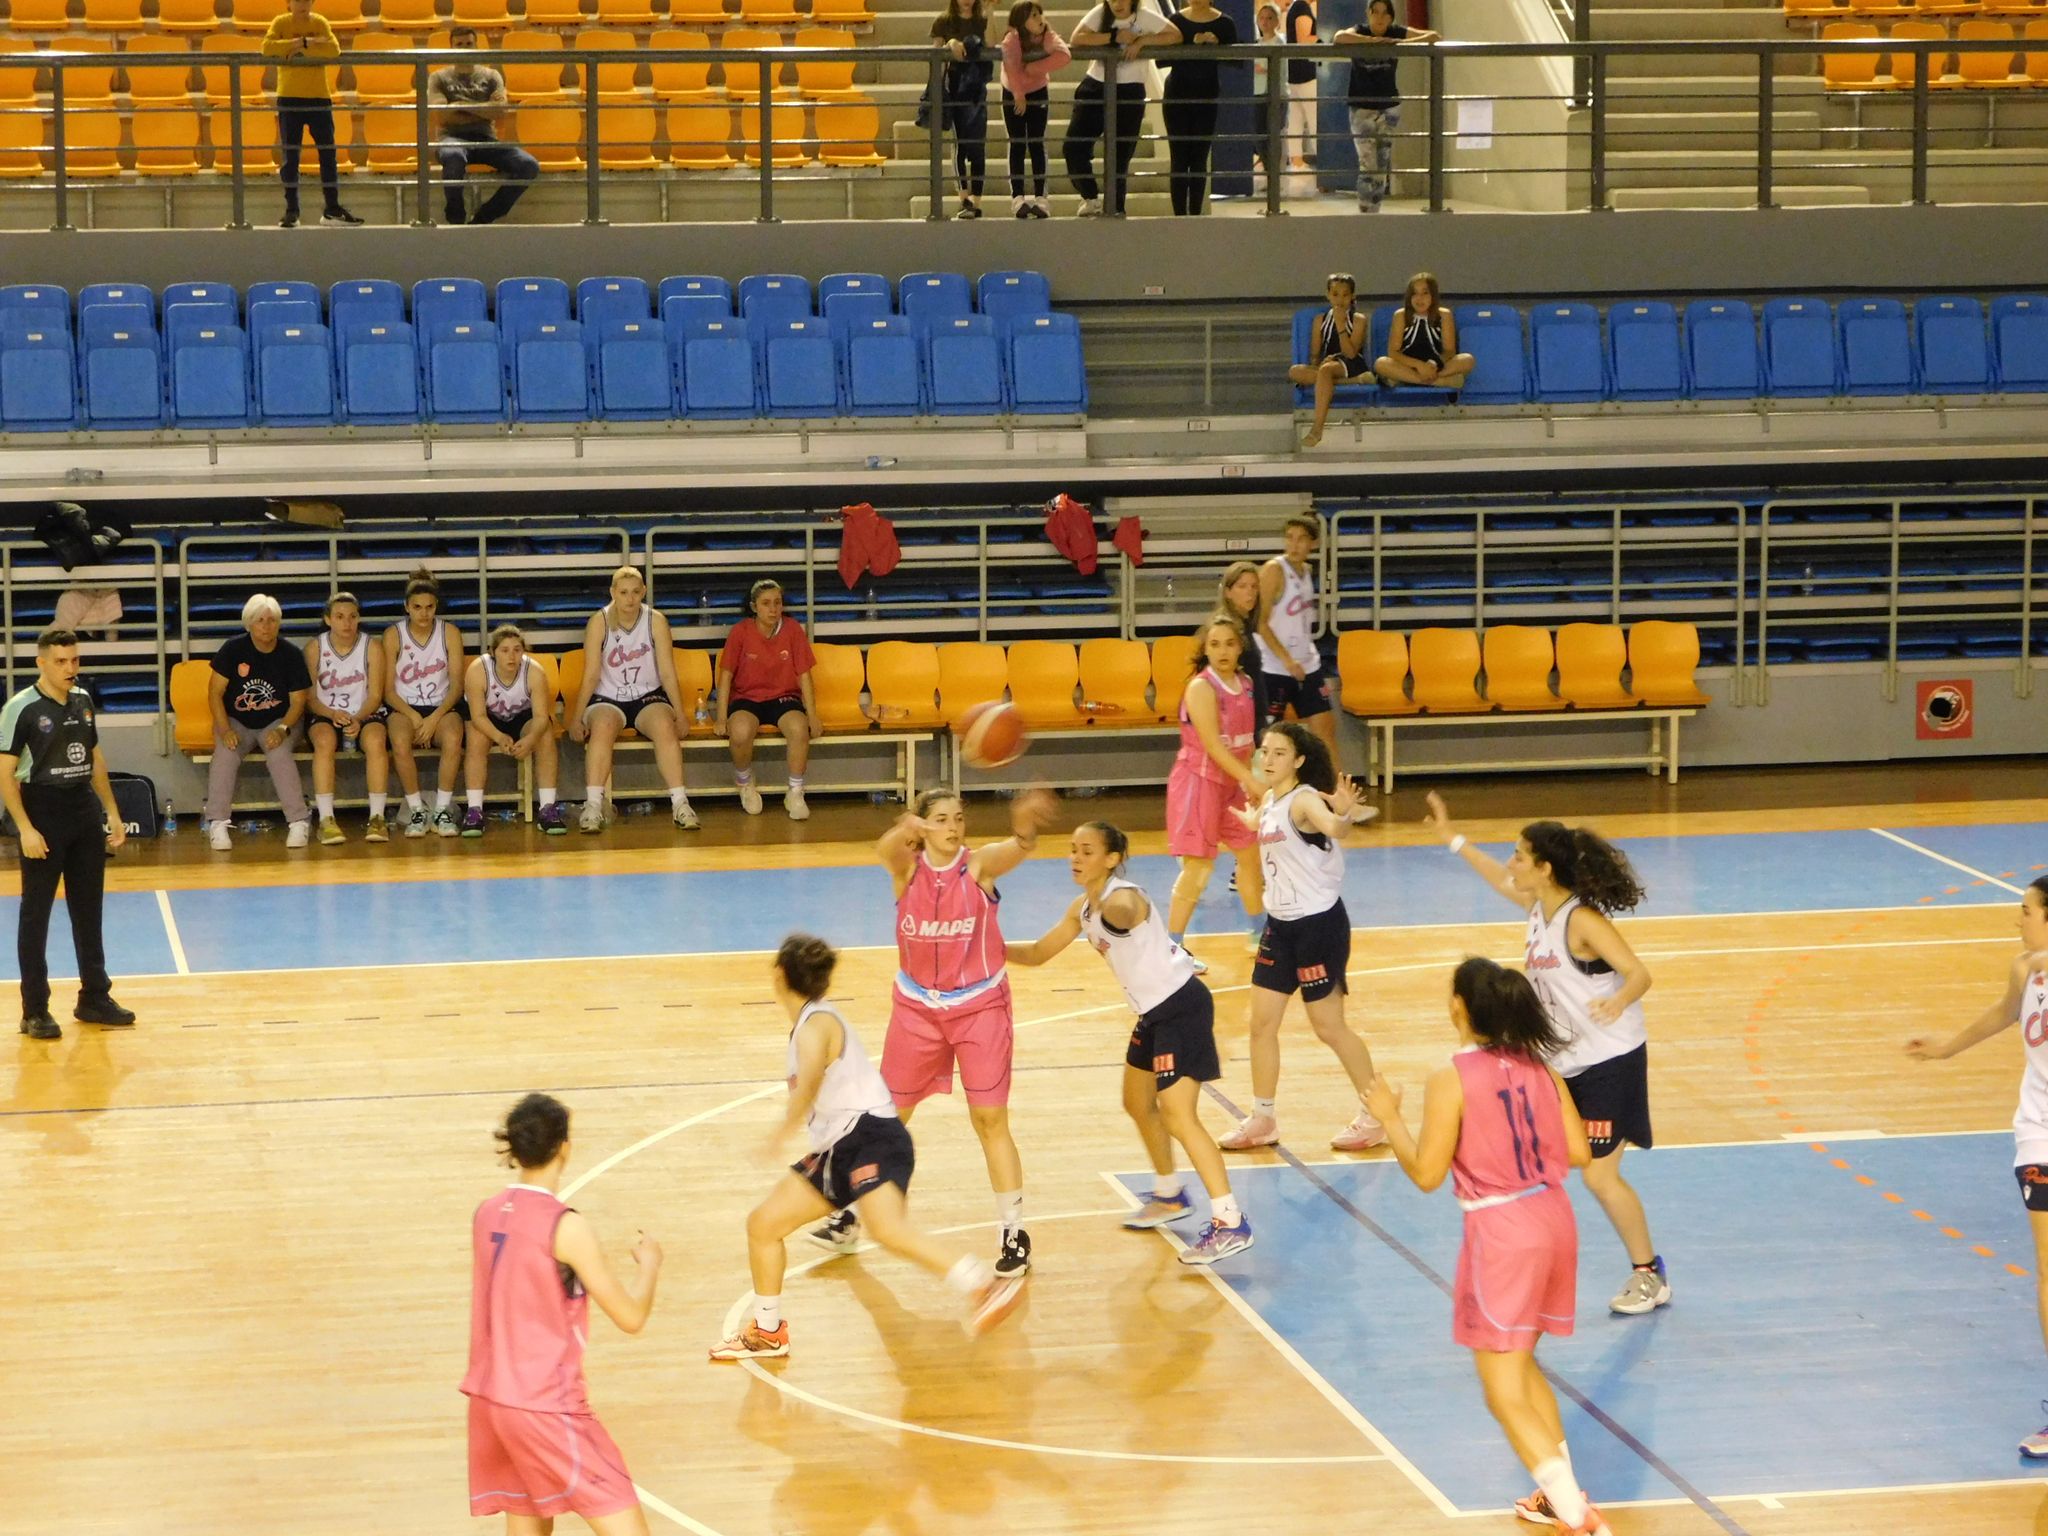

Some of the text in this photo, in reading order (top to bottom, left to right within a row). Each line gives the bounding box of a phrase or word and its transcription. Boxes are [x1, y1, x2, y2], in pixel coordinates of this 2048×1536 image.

[622, 666, 641, 685] 17
[416, 682, 437, 700] 12
[328, 693, 350, 709] 13
[1497, 1085, 1545, 1181] 11
[489, 1231, 508, 1276] 7
